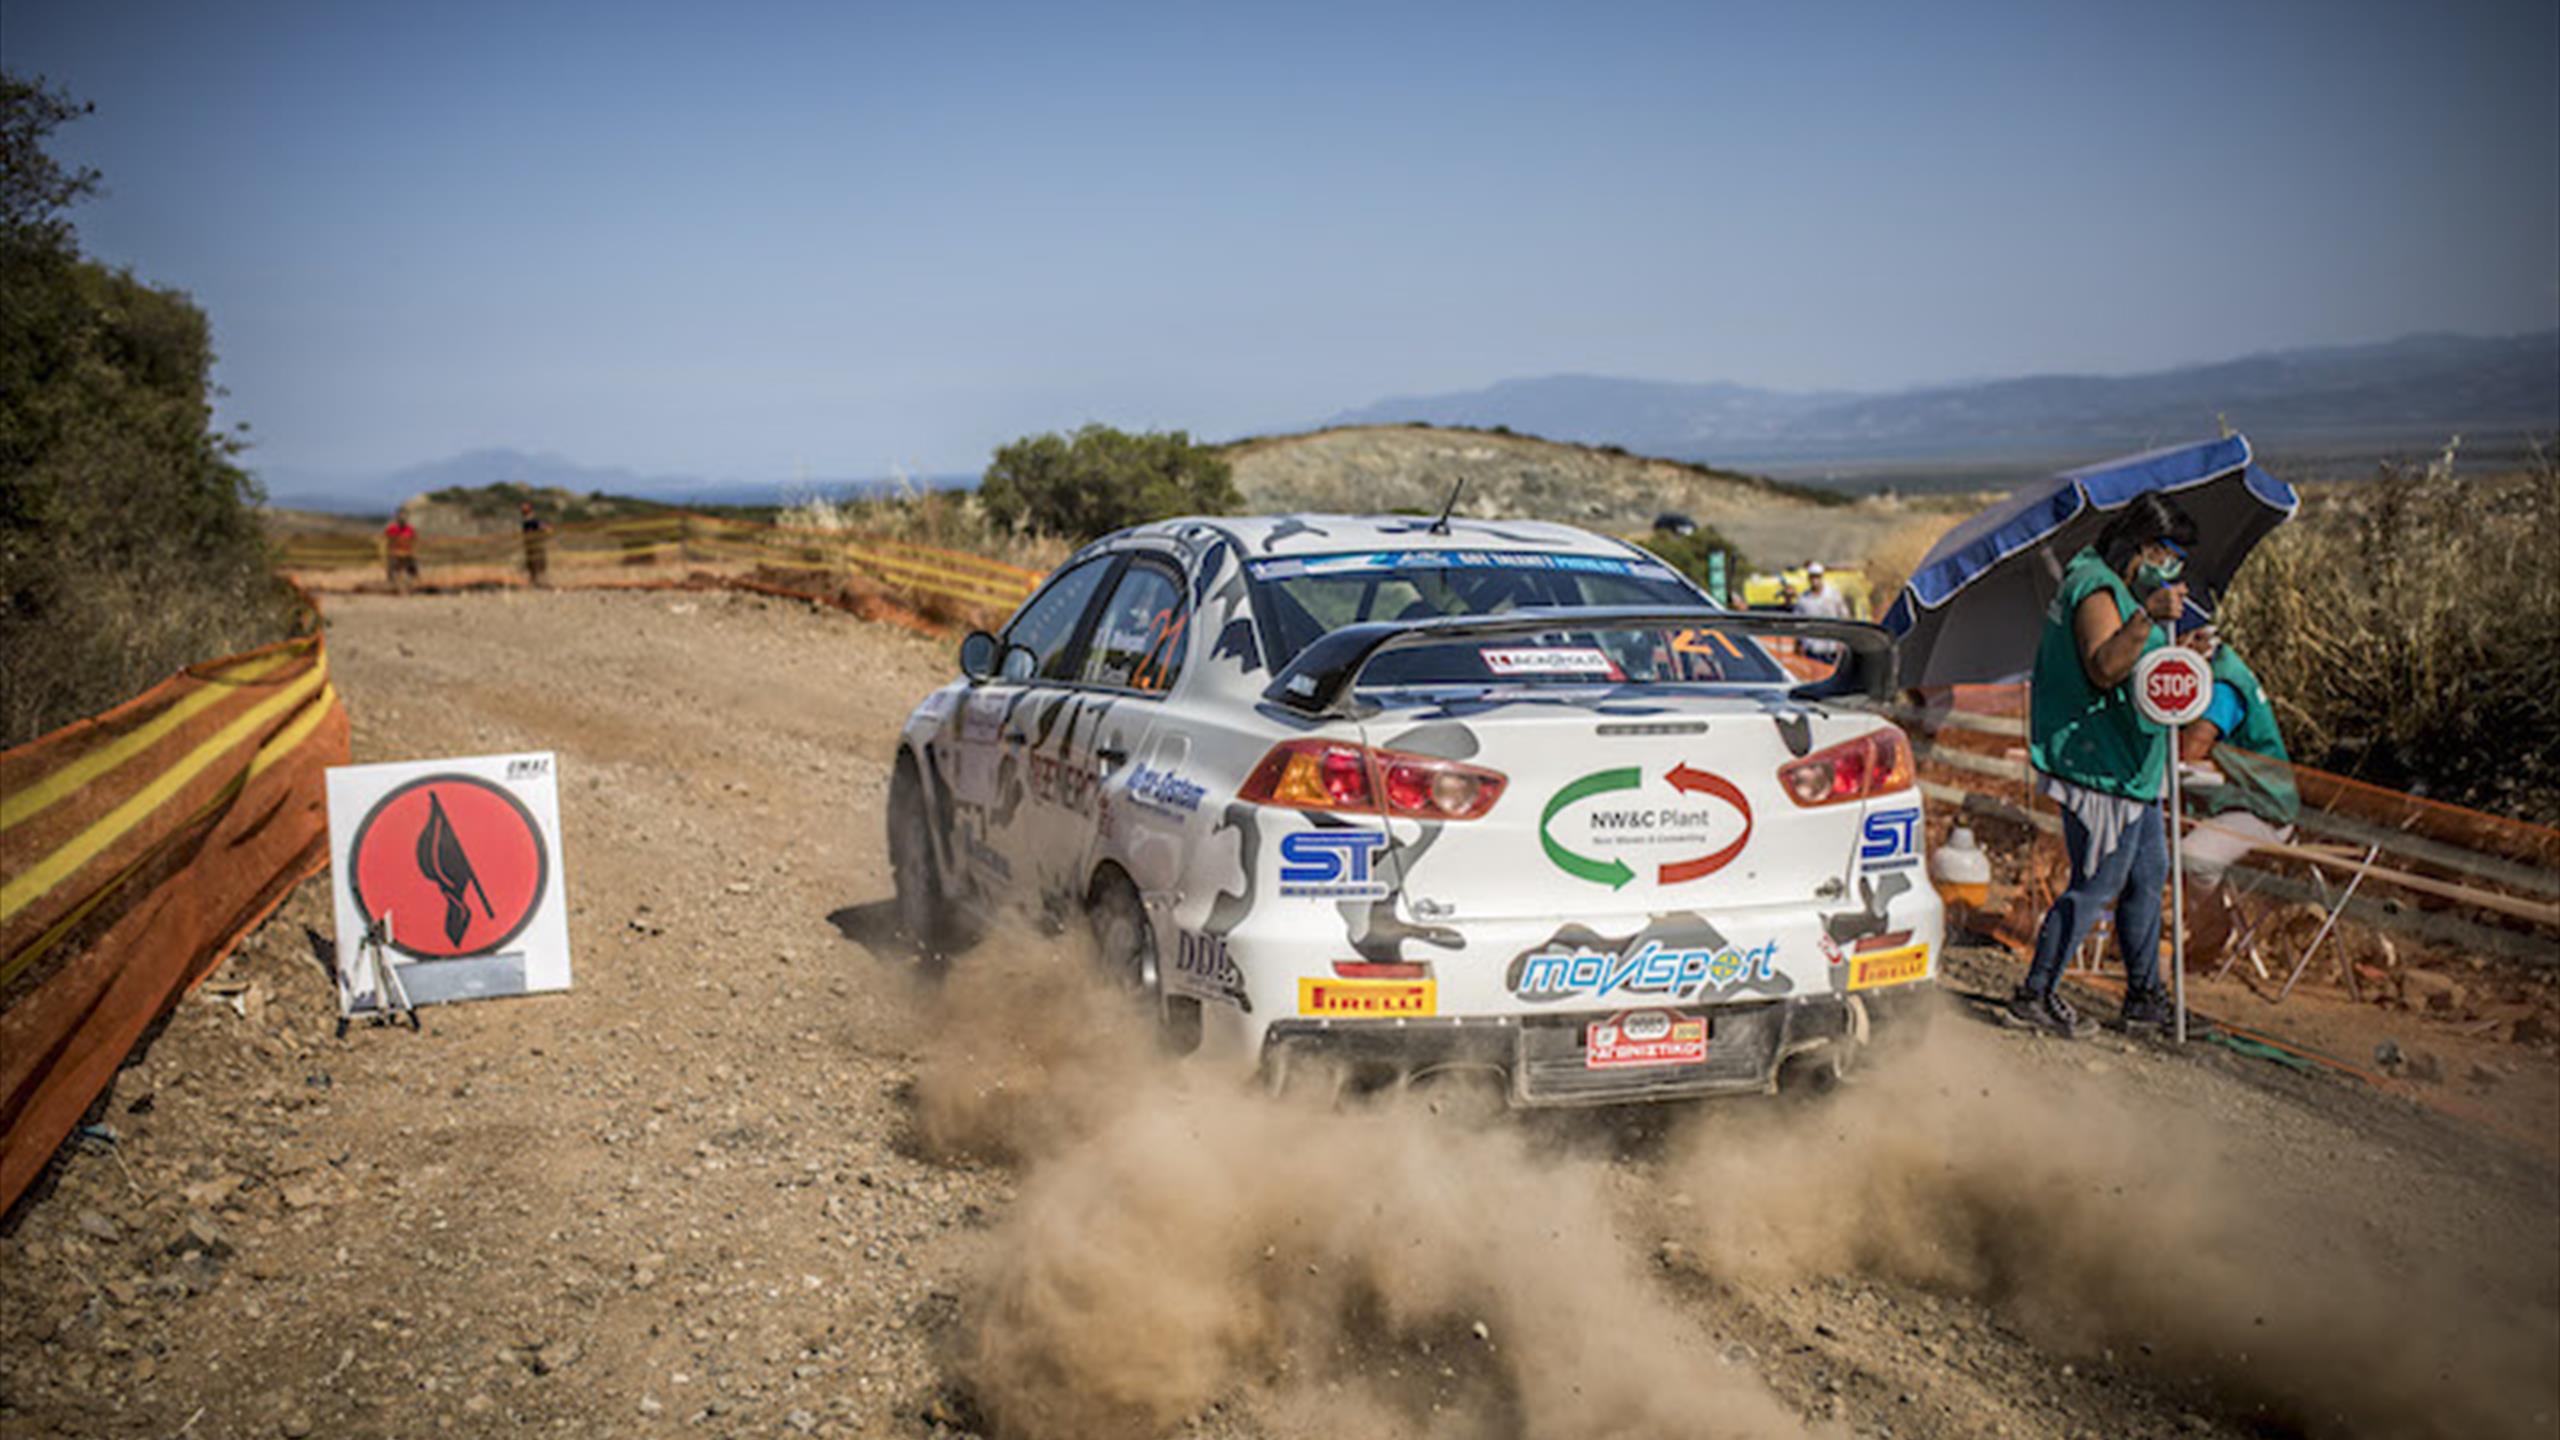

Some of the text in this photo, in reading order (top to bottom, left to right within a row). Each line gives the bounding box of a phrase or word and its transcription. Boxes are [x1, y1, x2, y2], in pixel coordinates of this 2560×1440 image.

[2149, 673, 2197, 698] STOP
[1590, 808, 1710, 829] NW&C Plant
[1862, 807, 1919, 858] ST
[1280, 832, 1385, 881] ST
[1857, 951, 1923, 984] PIRELLI
[1312, 986, 1424, 1010] PIRELLI
